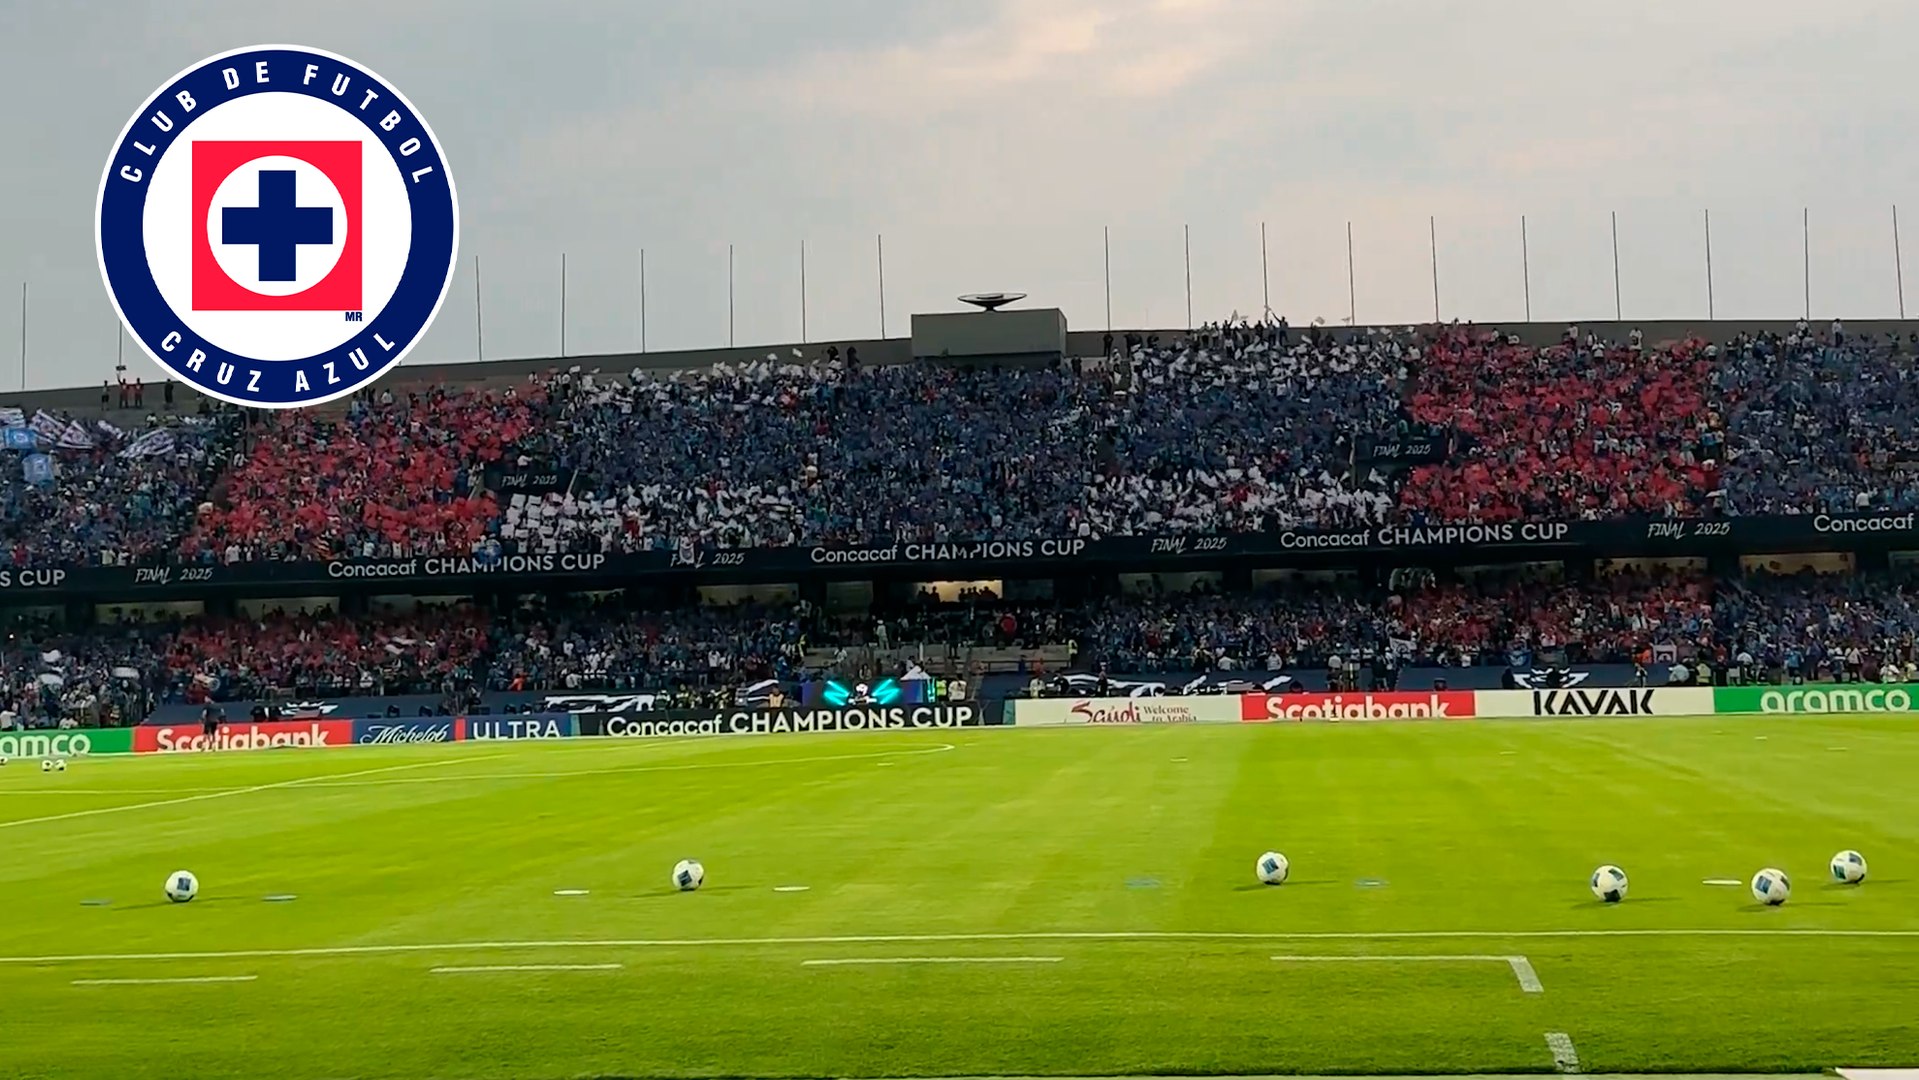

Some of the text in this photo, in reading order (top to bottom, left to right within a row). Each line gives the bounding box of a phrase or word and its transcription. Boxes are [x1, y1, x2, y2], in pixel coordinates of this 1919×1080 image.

[1405, 444, 1431, 455] 2025
[1648, 519, 1730, 540] FINAL 2025
[1814, 513, 1915, 532] Concacaf
[1151, 535, 1228, 553] FINAL 2025
[1280, 523, 1568, 549] Concacaf CHAMPIONS CUP
[712, 552, 745, 565] 2025
[811, 545, 897, 563] Concacaf
[1041, 539, 1085, 555] CUP
[135, 565, 213, 585] FINAL 2025
[328, 560, 416, 578] Concacaf
[561, 554, 605, 570] CUP
[19, 569, 66, 586] CUP
[1144, 706, 1189, 714] Welcome
[1266, 696, 1450, 720] Scotiabank
[1533, 689, 1655, 715] KAVAK
[1761, 689, 1911, 713] aramco
[607, 706, 973, 736] Concacaf CHAMPIONS CUP
[360, 720, 560, 745] Michelob ULTRA
